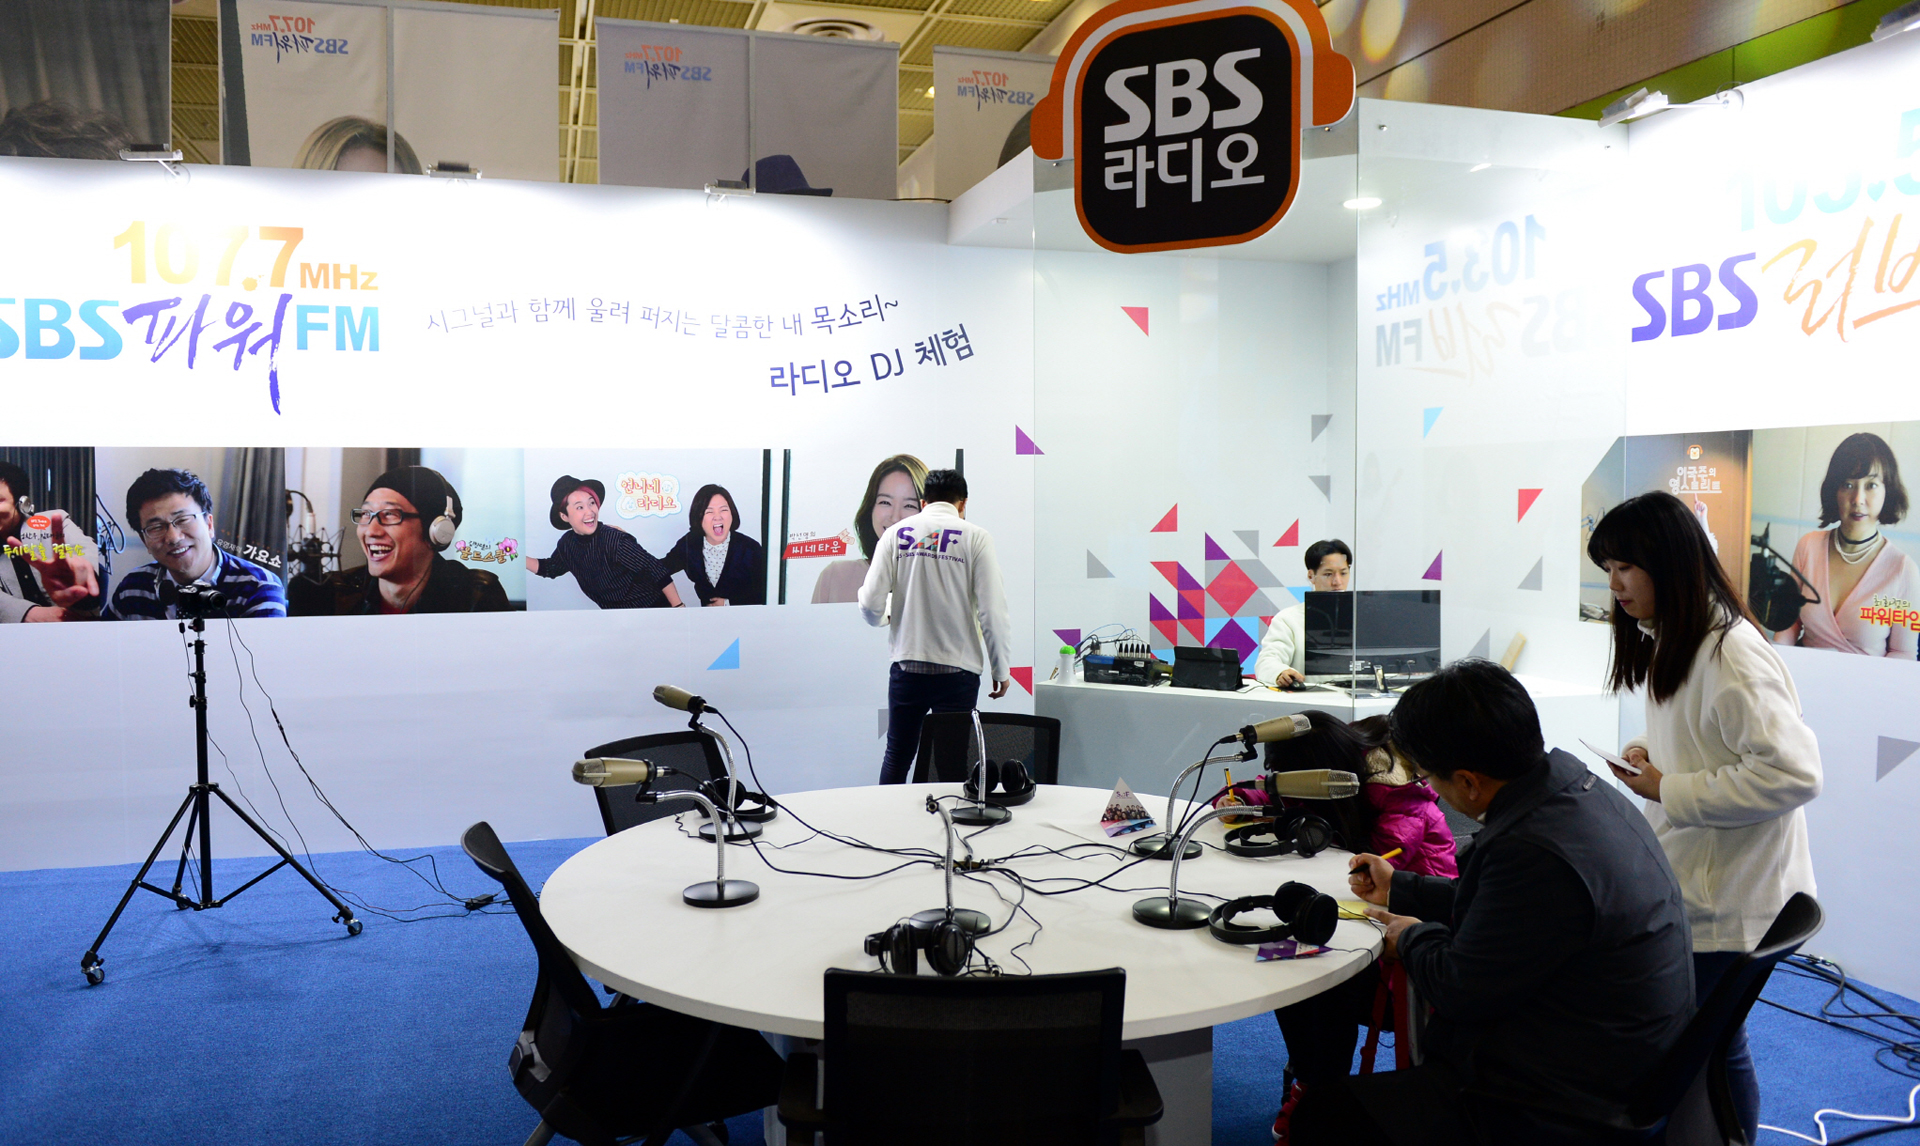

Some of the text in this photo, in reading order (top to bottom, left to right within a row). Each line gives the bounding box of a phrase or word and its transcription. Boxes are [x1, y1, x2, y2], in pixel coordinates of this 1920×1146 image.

[1104, 48, 1264, 144] SBS
[1104, 133, 1265, 209] 라디오
[113, 220, 379, 292] 107.7 MHz
[427, 300, 519, 334] 시그널과
[528, 297, 576, 323] 함께
[586, 297, 630, 325] 울려
[640, 305, 702, 337] 퍼지는
[711, 313, 775, 340] 달콤한
[782, 312, 803, 337] 내
[1631, 251, 1759, 343] SBS
[121, 293, 293, 417] 파워
[296, 304, 380, 353] FM
[769, 322, 975, 397] 라디오 DJ 체험
[621, 477, 661, 495] 언니네
[636, 494, 677, 511] 라디오
[2, 542, 85, 561] 두시탈출 컬투쇼
[243, 543, 282, 569] 가요쇼
[460, 546, 507, 565] 올드스쿨
[791, 540, 842, 555] 씨네타운
